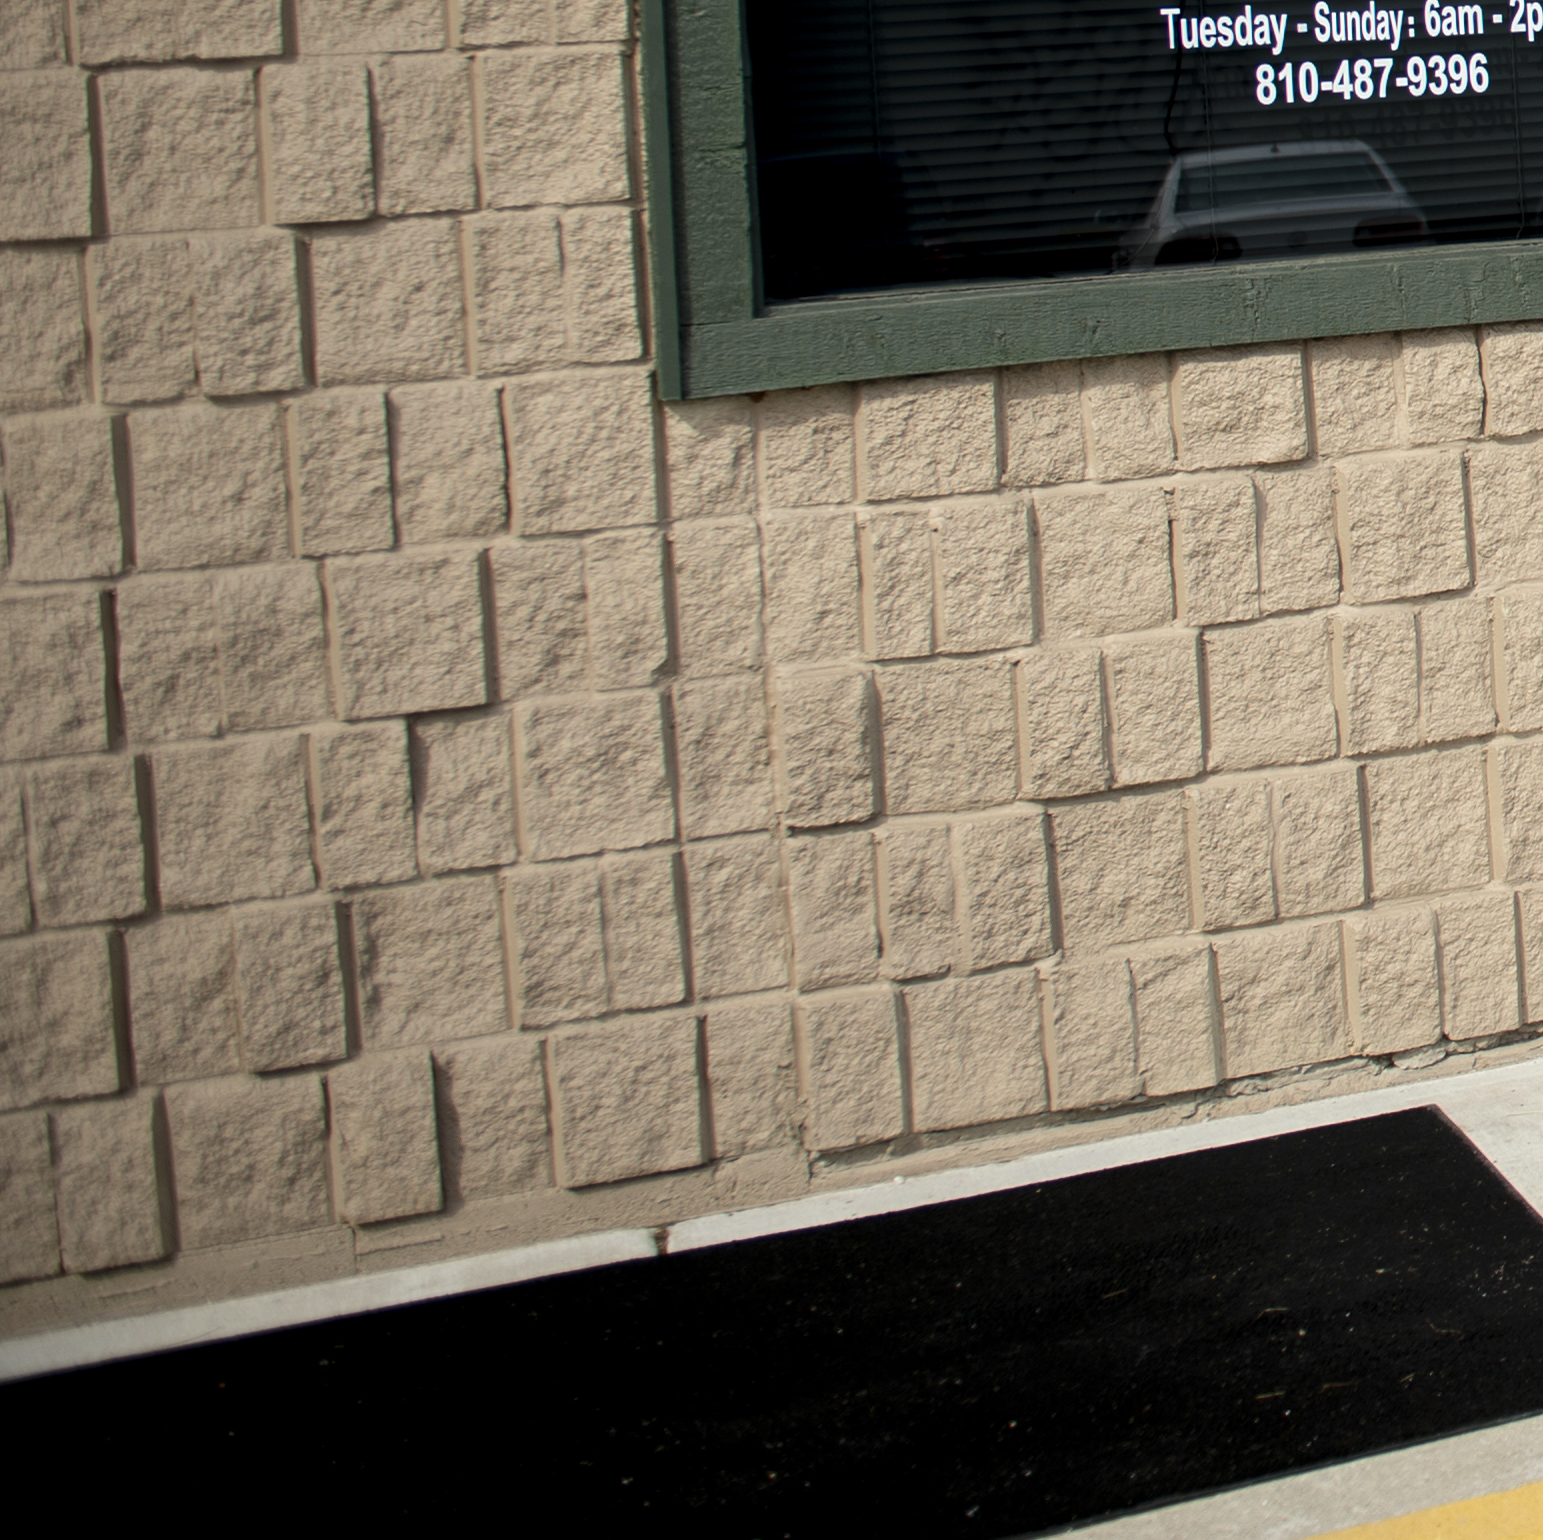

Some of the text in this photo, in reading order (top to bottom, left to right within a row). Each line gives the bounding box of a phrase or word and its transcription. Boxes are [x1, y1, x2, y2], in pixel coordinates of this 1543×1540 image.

[1160, 4, 1287, 56] Tuesday
[1314, 0, 1415, 51] Sunday:
[1255, 52, 1489, 105] 810-487-9396
